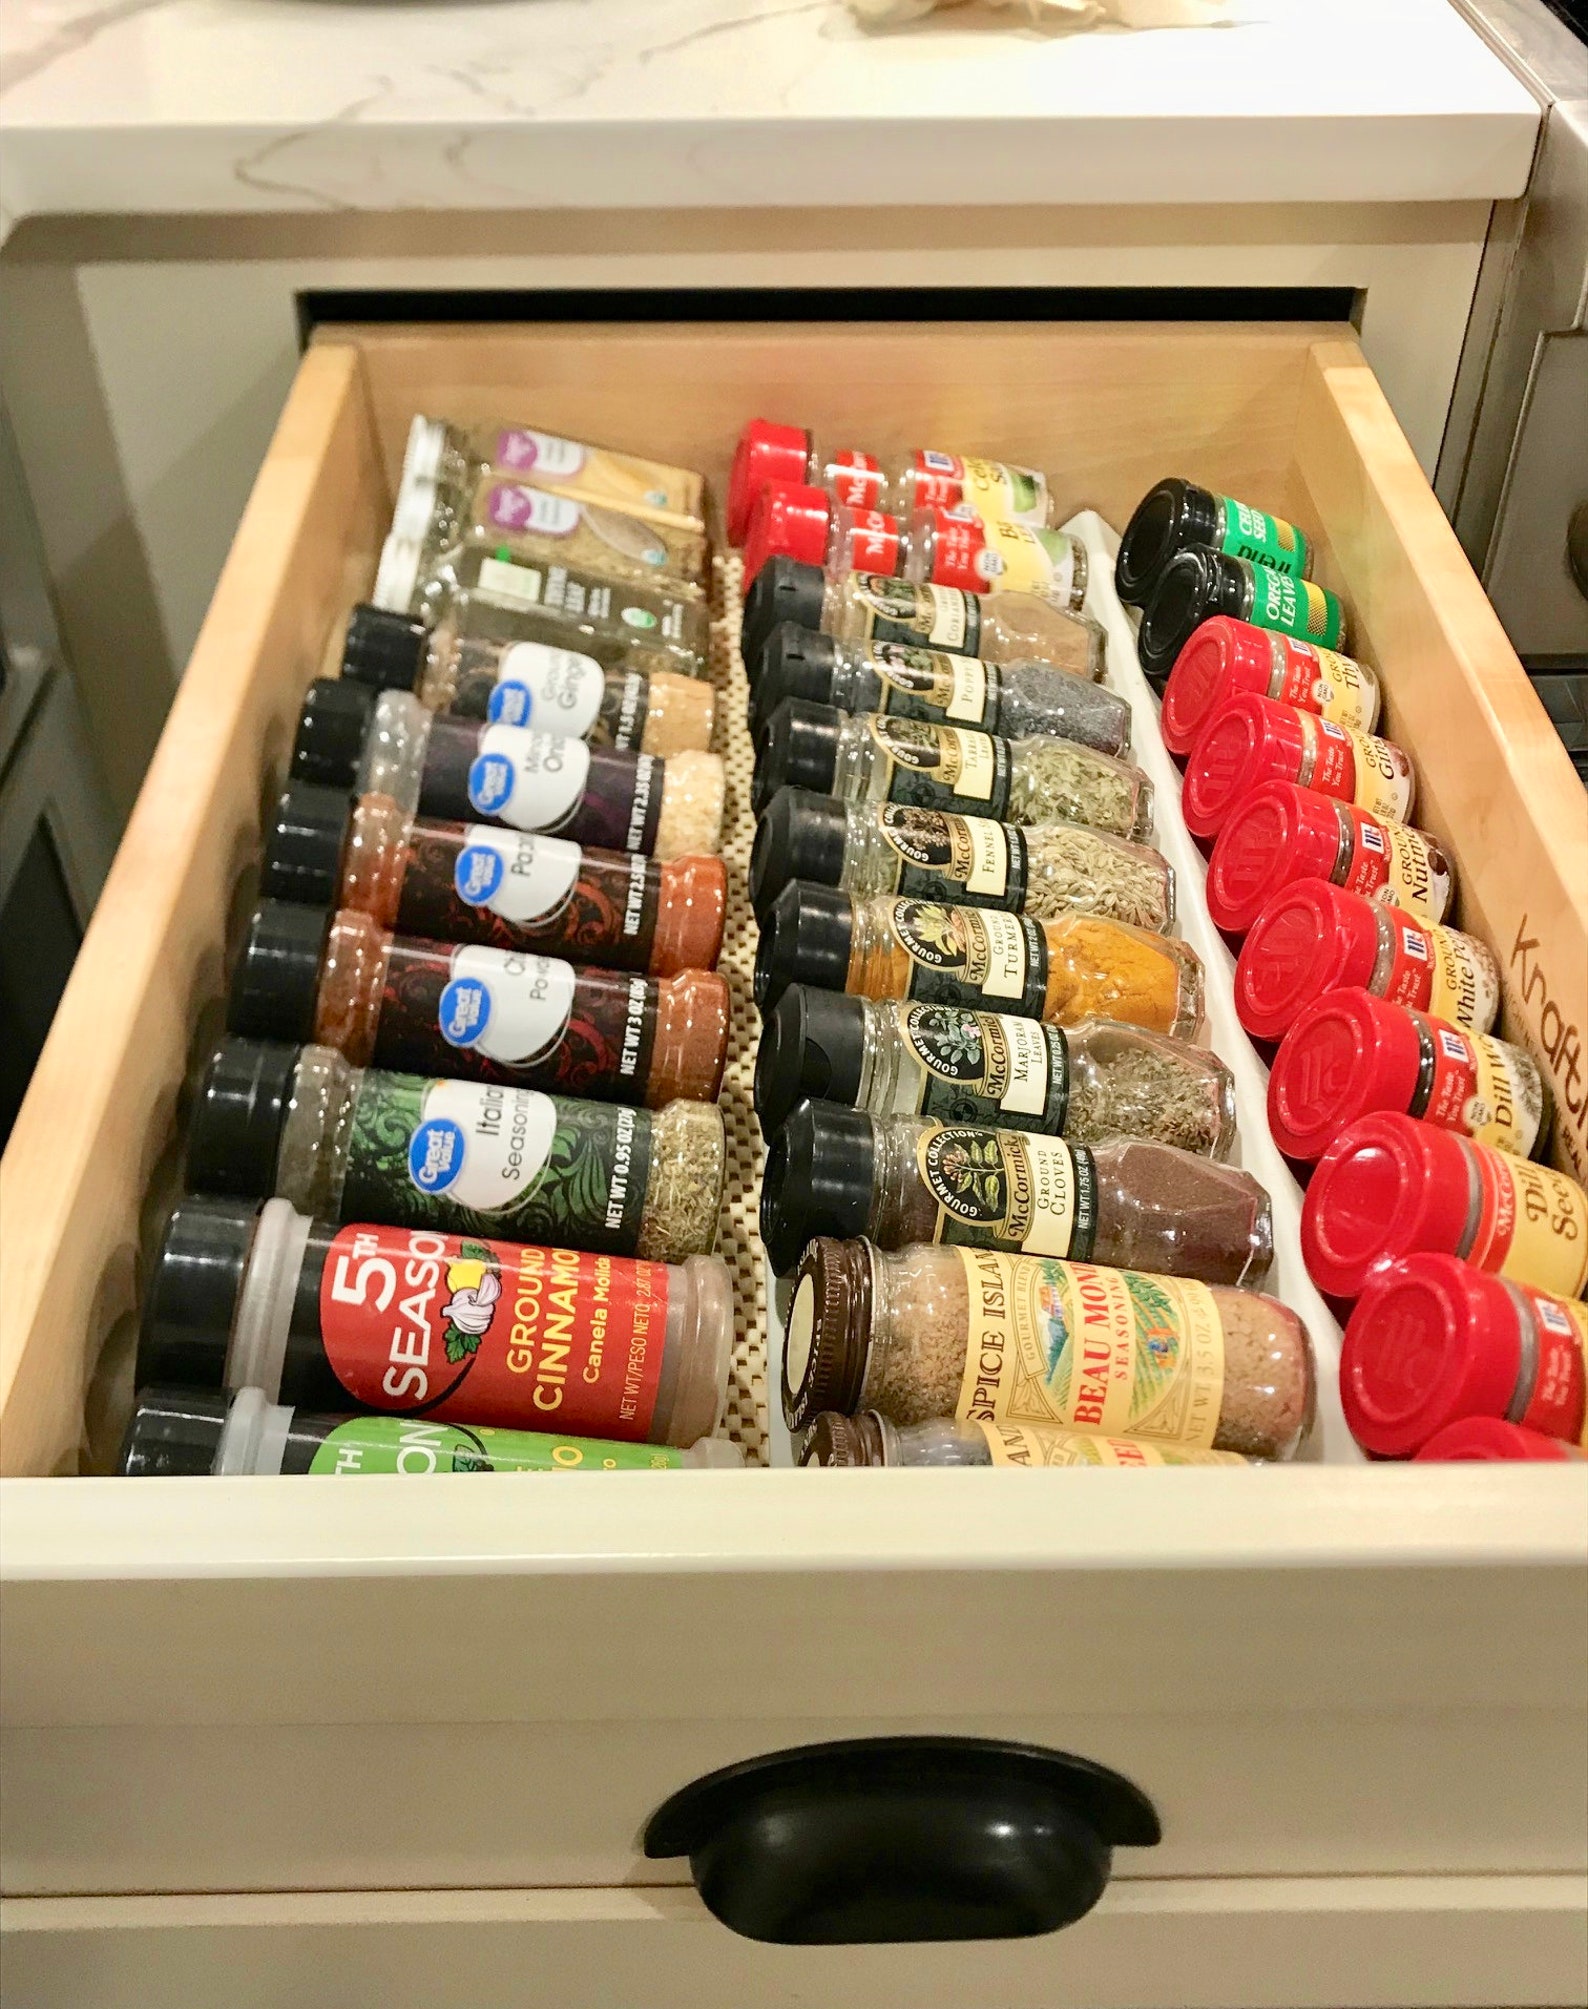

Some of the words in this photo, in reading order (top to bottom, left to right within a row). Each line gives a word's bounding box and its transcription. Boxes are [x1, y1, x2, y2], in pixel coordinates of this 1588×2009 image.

[1325, 746, 1335, 765] Taste
[1335, 748, 1345, 770] Trust
[1322, 766, 1332, 782] The
[1331, 772, 1341, 786] You
[1356, 861, 1368, 883] Taste
[1367, 867, 1378, 890] Trust
[1398, 970, 1410, 993] Taste
[1409, 974, 1420, 999] Trust
[453, 986, 471, 1037] Great
[467, 989, 482, 1027] Value
[623, 1031, 641, 1055] WT
[620, 1055, 634, 1075] NET
[1441, 1070, 1453, 1096] Taste
[1452, 1075, 1465, 1102] Trust
[1436, 1099, 1450, 1117] The
[1447, 1104, 1460, 1122] You
[1471, 1102, 1479, 1119] NON
[1492, 1075, 1512, 1128] Dill
[615, 1123, 635, 1143] OZ
[419, 1128, 444, 1184] Great
[436, 1131, 455, 1173] Value
[614, 1141, 633, 1175] 0.95
[608, 1175, 628, 1206] WT
[928, 1170, 978, 1217] GOURMET
[1008, 1138, 1029, 1237] McCormick
[1037, 1150, 1049, 1210] GROUND
[1050, 1151, 1066, 1216] CLOVES
[1078, 1194, 1090, 1212] WT
[605, 1206, 622, 1229] NET
[1077, 1213, 1088, 1230] NET
[592, 1255, 610, 1303] Molida
[507, 1247, 545, 1374] GROUND
[636, 1303, 650, 1334] NETO
[1113, 1276, 1128, 1381] SEASONING
[583, 1307, 610, 1385] Canela
[624, 1337, 647, 1396] WT/PESO
[966, 1331, 1006, 1422] SPICE
[1073, 1337, 1111, 1426] BEAU
[619, 1393, 634, 1421] NET
